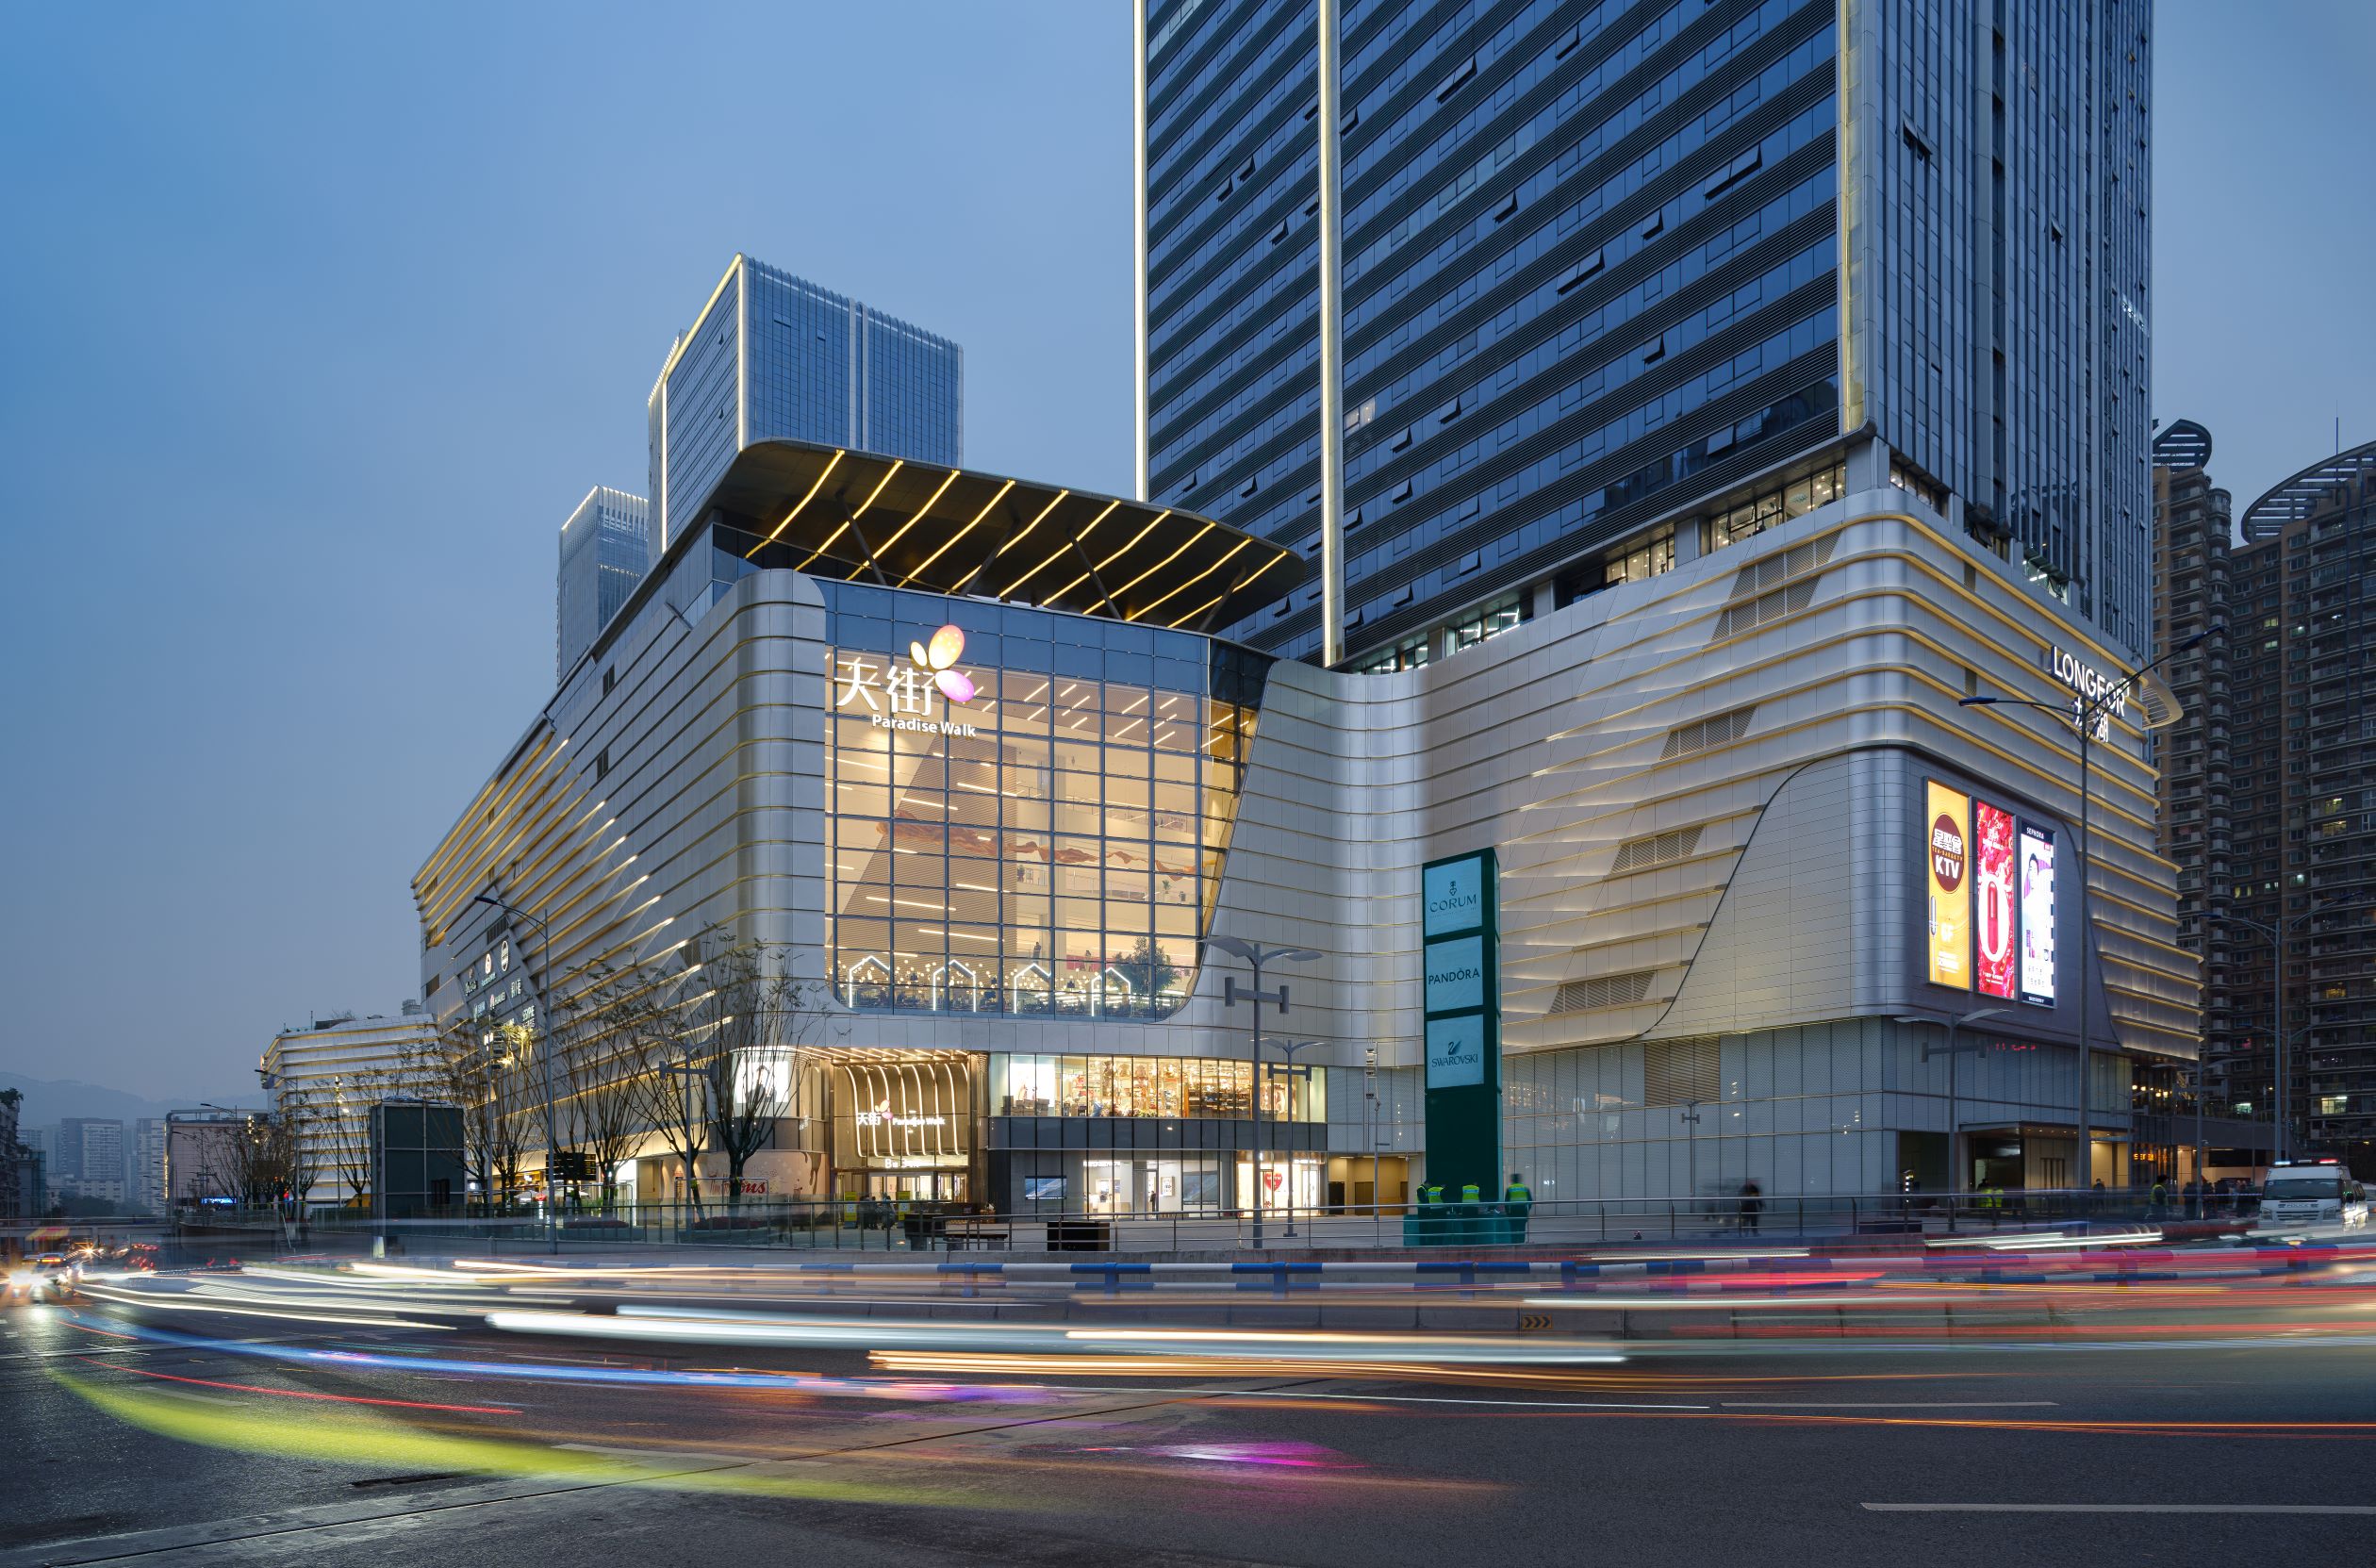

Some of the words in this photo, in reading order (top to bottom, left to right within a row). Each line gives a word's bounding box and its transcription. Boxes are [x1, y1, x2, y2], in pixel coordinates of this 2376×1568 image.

[833, 660, 934, 717] 天街
[2053, 645, 2125, 718] LONGFOR
[871, 714, 937, 734] Paradise
[940, 722, 977, 737] Walk
[1935, 854, 1960, 880] KTV
[1429, 893, 1477, 913] CORUM
[1427, 967, 1480, 985] PANDORA
[1431, 1053, 1478, 1068] SWAROVSKI
